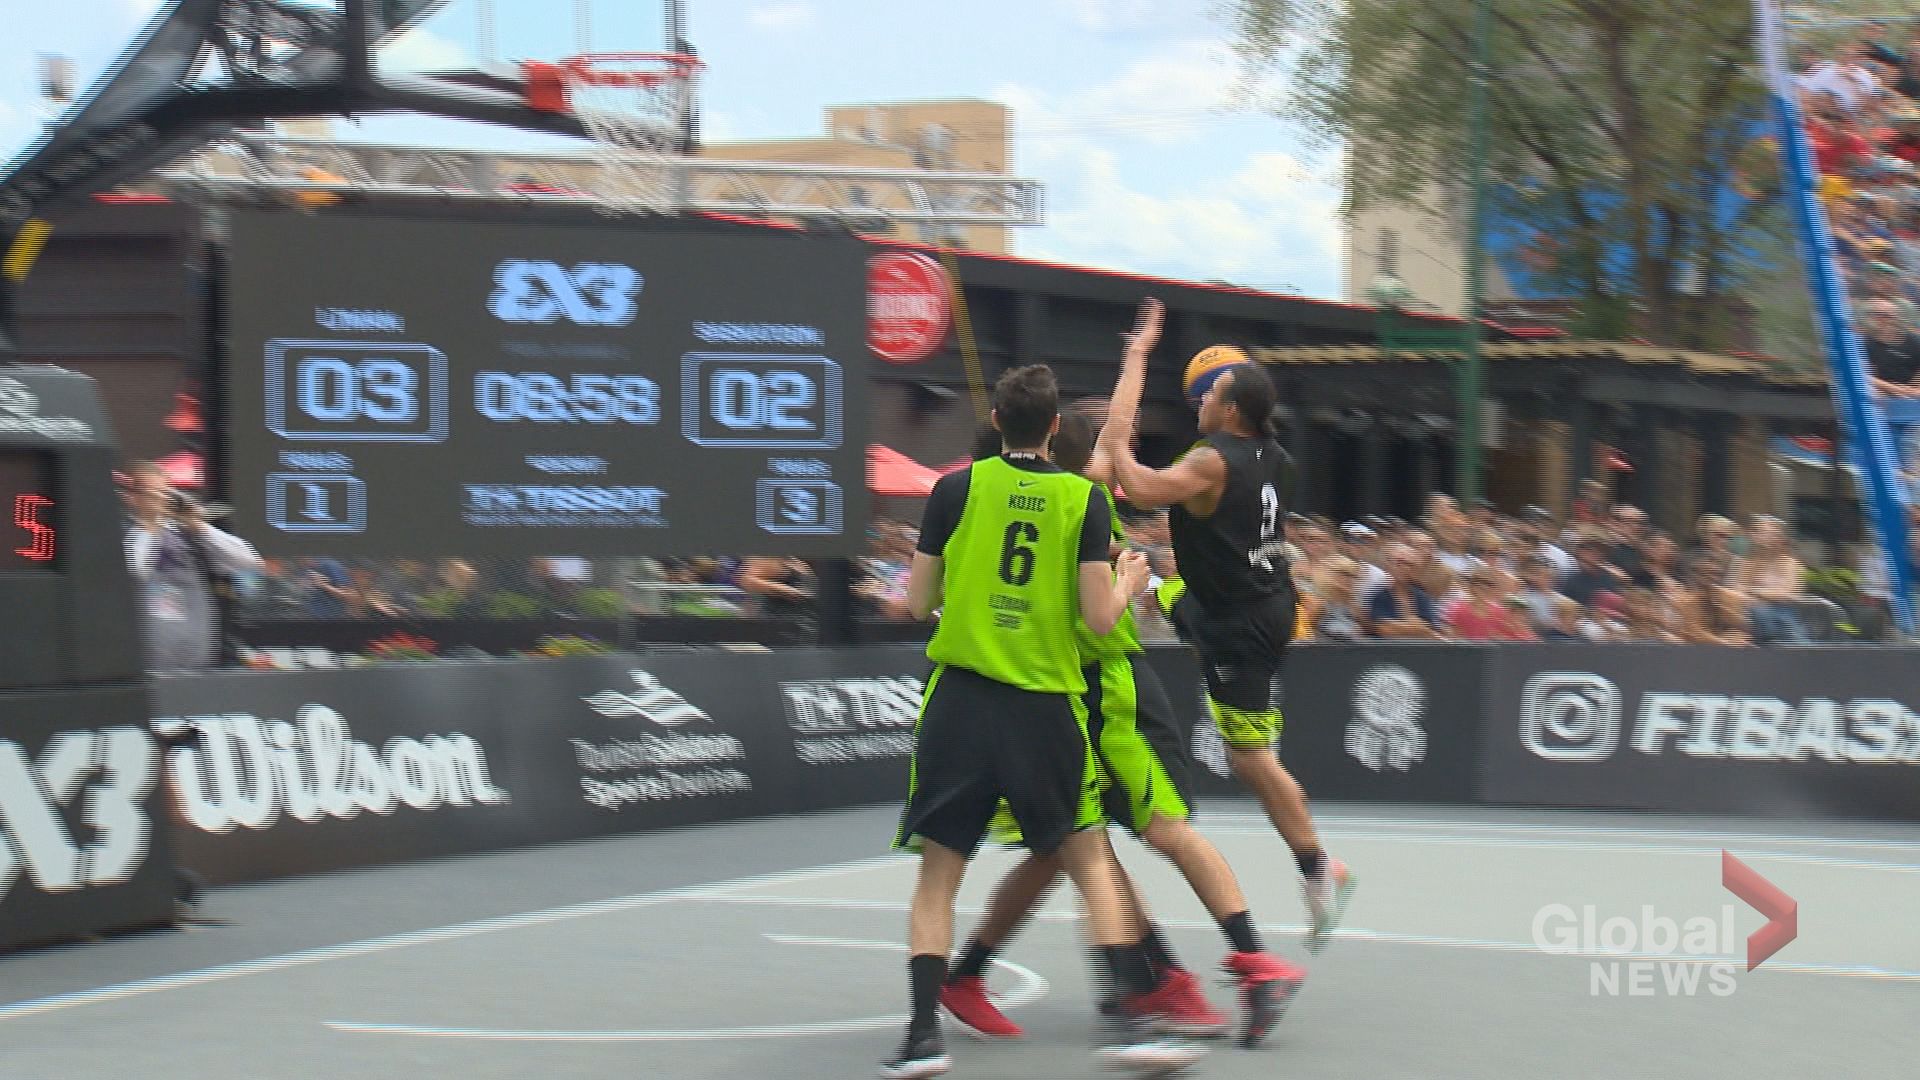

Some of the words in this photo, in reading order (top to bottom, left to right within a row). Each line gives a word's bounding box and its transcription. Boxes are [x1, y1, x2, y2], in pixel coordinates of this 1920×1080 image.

[296, 357, 419, 422] 03
[472, 370, 662, 424] 08:58
[709, 369, 818, 430] 02
[13, 494, 56, 560] 5
[300, 483, 335, 521] 1
[781, 488, 819, 523] 3
[998, 520, 1040, 587] 6
[838, 675, 926, 727] TISS
[150, 702, 508, 833] Wilson
